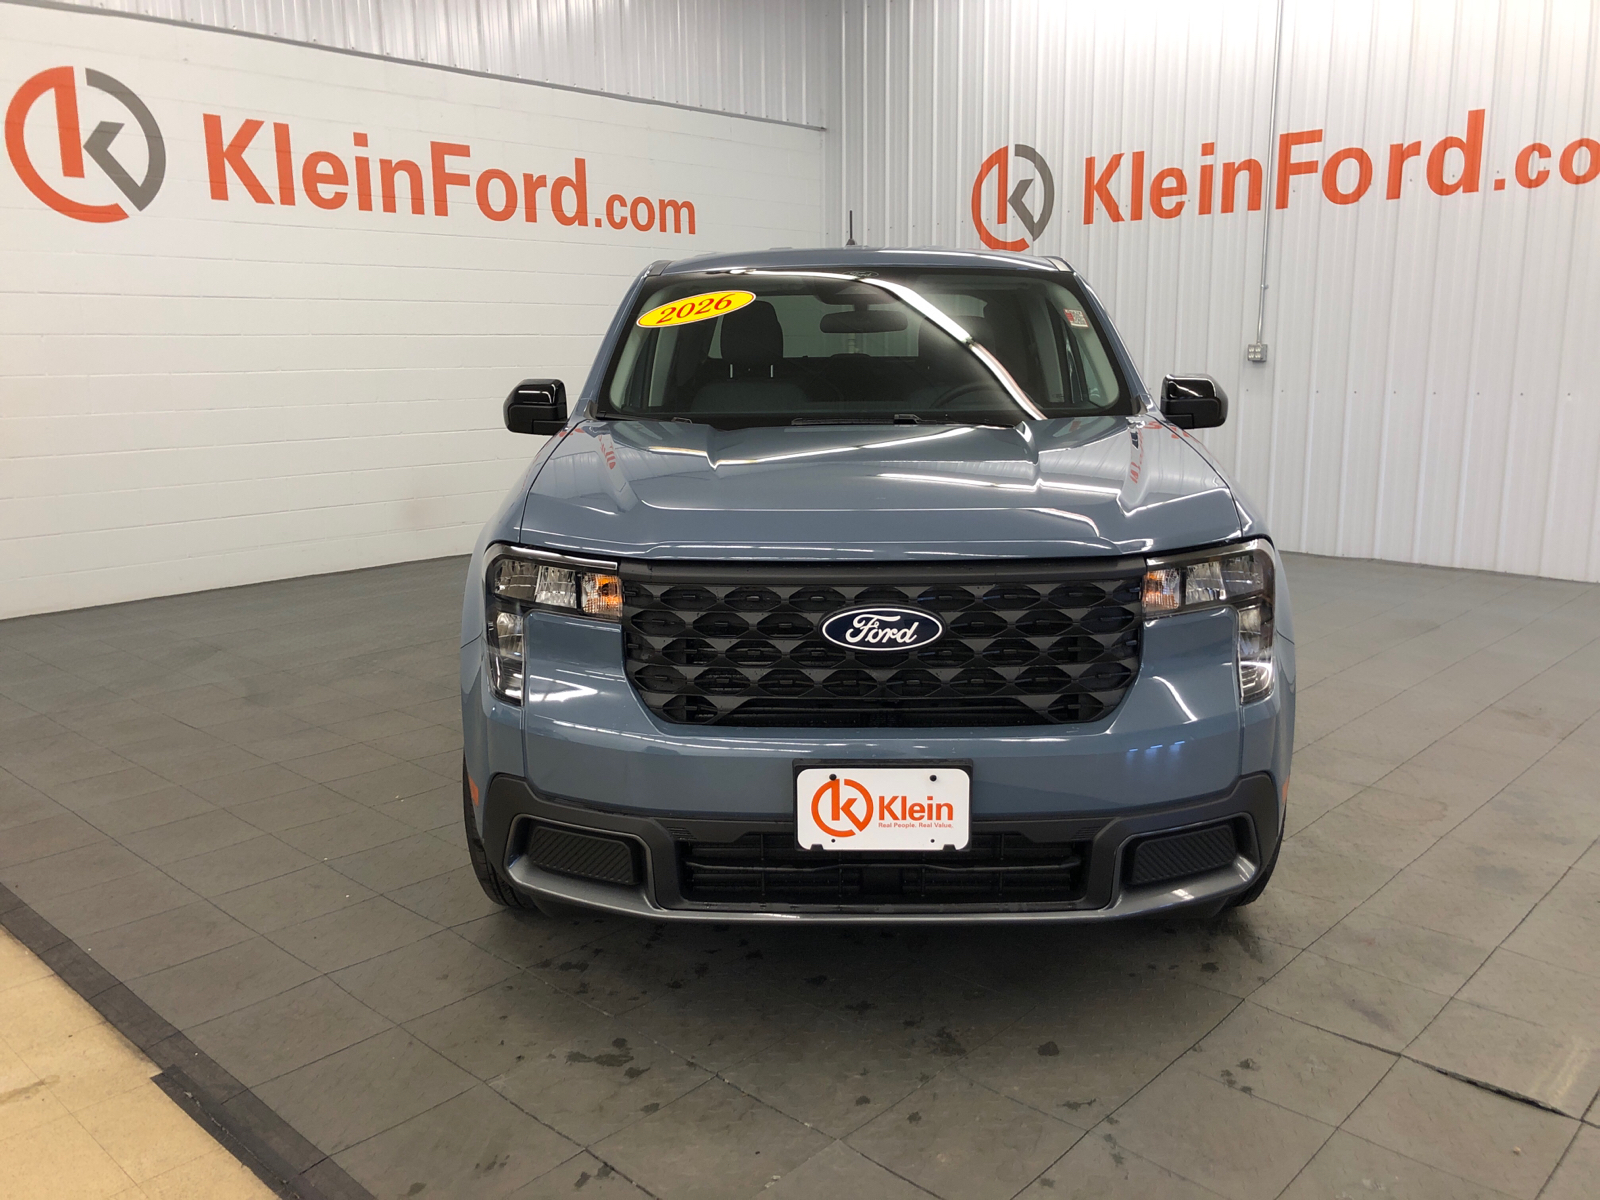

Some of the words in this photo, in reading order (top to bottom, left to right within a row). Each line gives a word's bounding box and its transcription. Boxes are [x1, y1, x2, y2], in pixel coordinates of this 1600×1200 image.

[203, 114, 696, 235] KleinFord.com
[656, 293, 736, 324] 2026
[845, 613, 919, 643] Ford
[878, 795, 954, 821] Klein
